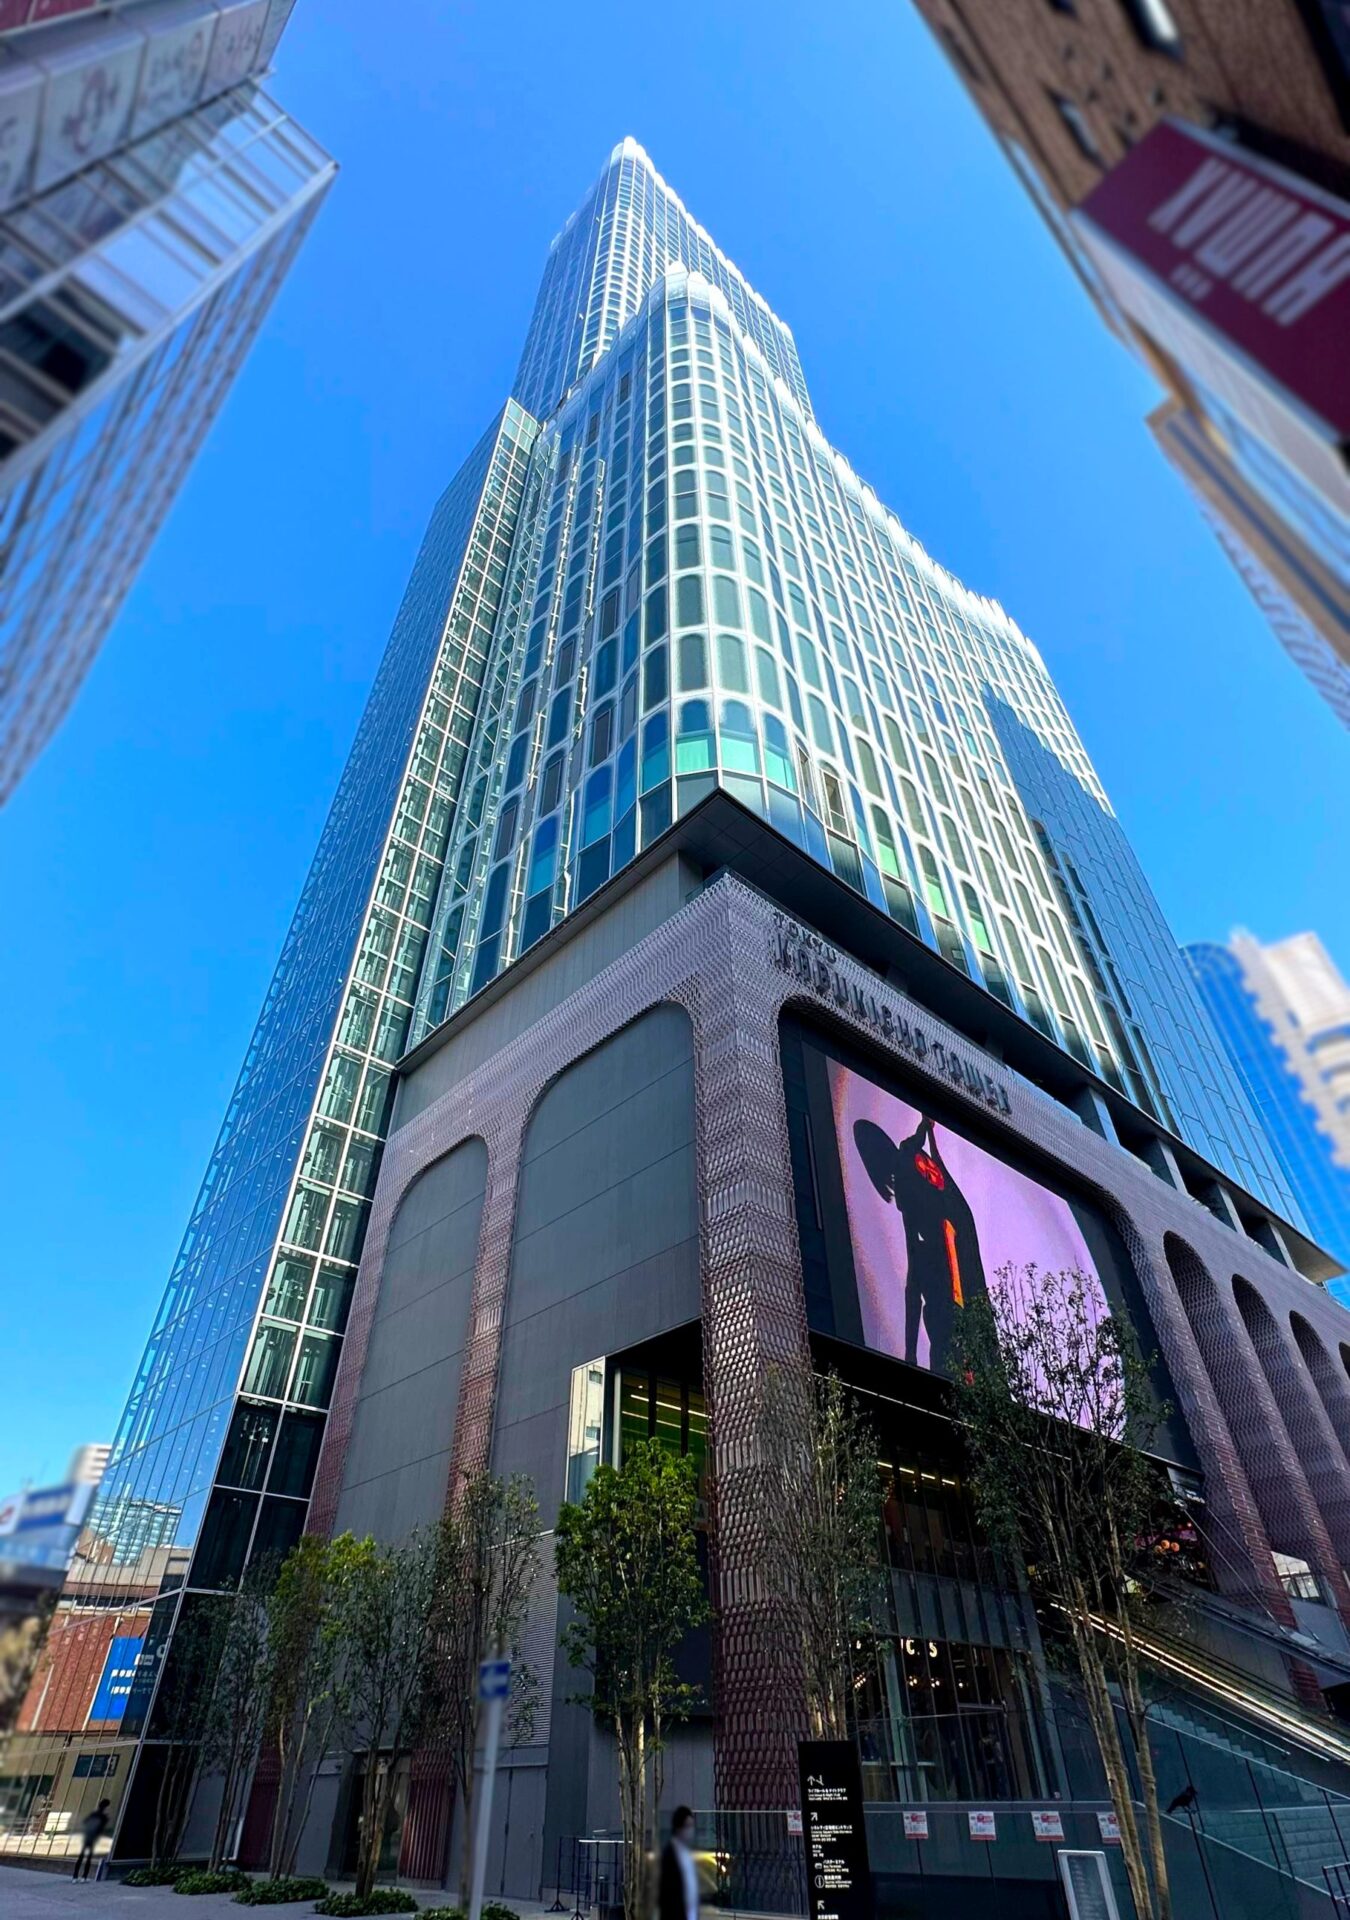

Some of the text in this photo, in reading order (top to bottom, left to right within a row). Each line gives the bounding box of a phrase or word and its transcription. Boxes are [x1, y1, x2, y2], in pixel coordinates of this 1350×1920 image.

[1146, 156, 1350, 328] HUMAX
[773, 911, 838, 964] TOKYU
[931, 1040, 1013, 1115] TOWER
